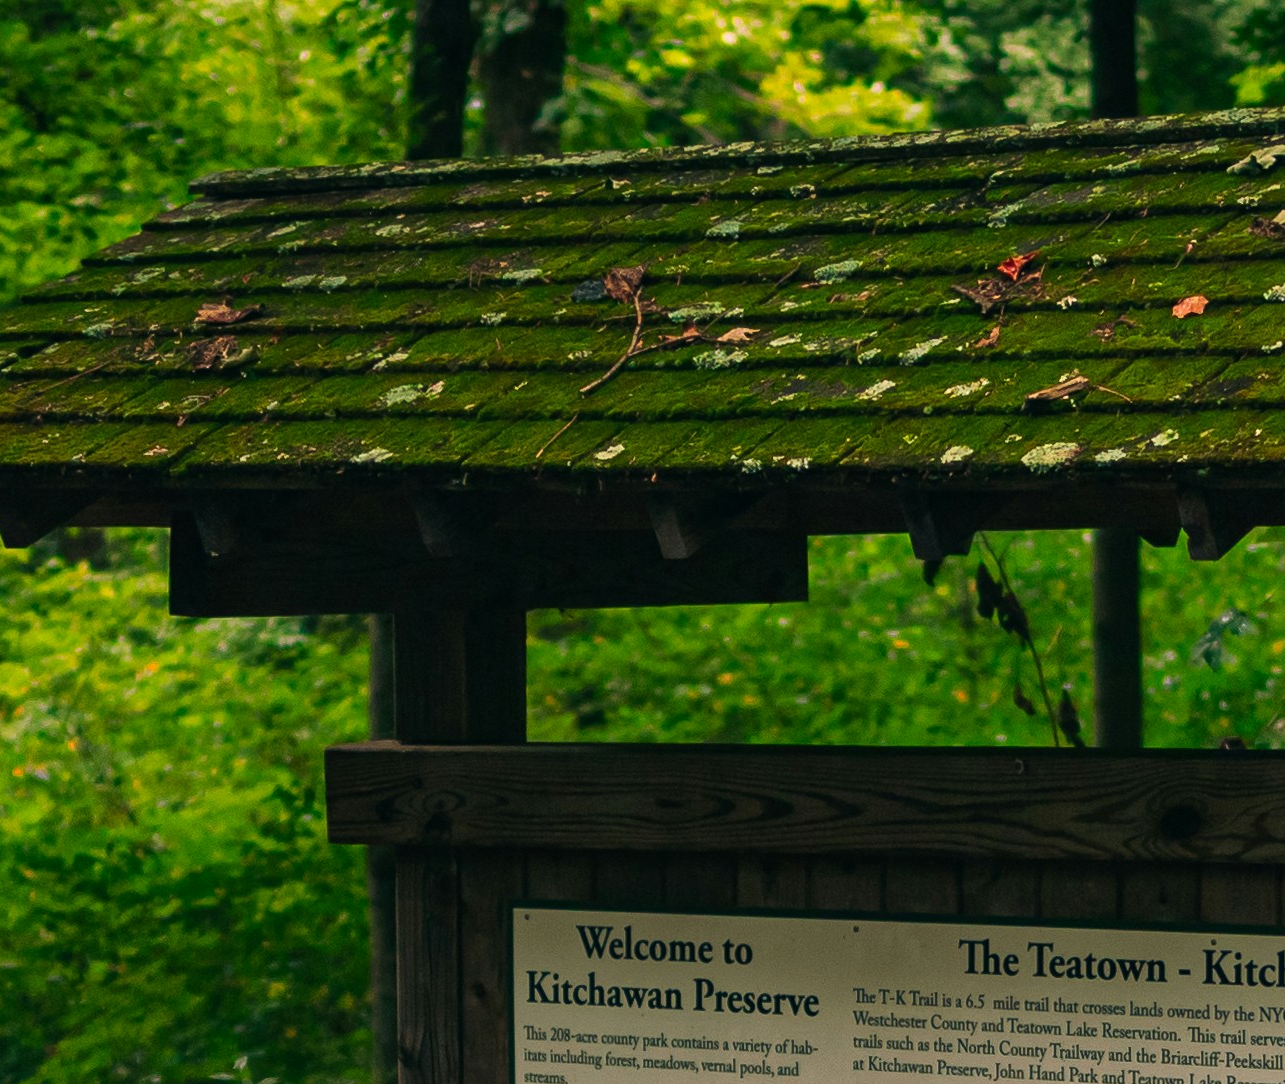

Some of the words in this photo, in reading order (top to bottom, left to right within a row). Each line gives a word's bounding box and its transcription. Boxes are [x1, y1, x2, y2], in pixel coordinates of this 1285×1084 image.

[576, 925, 713, 964] Welcome
[722, 939, 753, 965] to
[958, 938, 1019, 976] The
[1028, 942, 1168, 982] Teatown
[526, 970, 683, 1010] Kitchawan
[693, 978, 819, 1017] Preserve
[852, 988, 876, 1004] The
[879, 990, 906, 1005] T-K
[909, 991, 938, 1007] Trail
[942, 994, 952, 1008] is
[955, 998, 962, 1008] a
[966, 994, 985, 1009] 6.5
[993, 996, 1020, 1010] mile
[1024, 997, 1049, 1012] trail
[1053, 998, 1078, 1014] that
[1082, 1004, 1126, 1016] crosses
[1130, 1001, 1163, 1018] lands
[1167, 1004, 1210, 1020] owned
[1214, 1005, 1230, 1025] by
[1234, 1006, 1255, 1022] the
[523, 1025, 547, 1041] This
[550, 1027, 598, 1044] 208-acre
[601, 1034, 640, 1051] county
[642, 1032, 668, 1052] park
[671, 1036, 720, 1050] contains
[722, 1041, 730, 1051] a
[732, 1038, 772, 1058] variety
[775, 1039, 790, 1054] of
[791, 1039, 818, 1055] hab-
[524, 1048, 547, 1062] itats
[550, 1049, 602, 1070] including
[605, 1051, 641, 1070] forest,
[642, 1055, 699, 1073] meadows,
[701, 1058, 737, 1073] vernal
[740, 1059, 775, 1079] pools,
[777, 1061, 799, 1076] and
[524, 1072, 568, 1084] streams.
